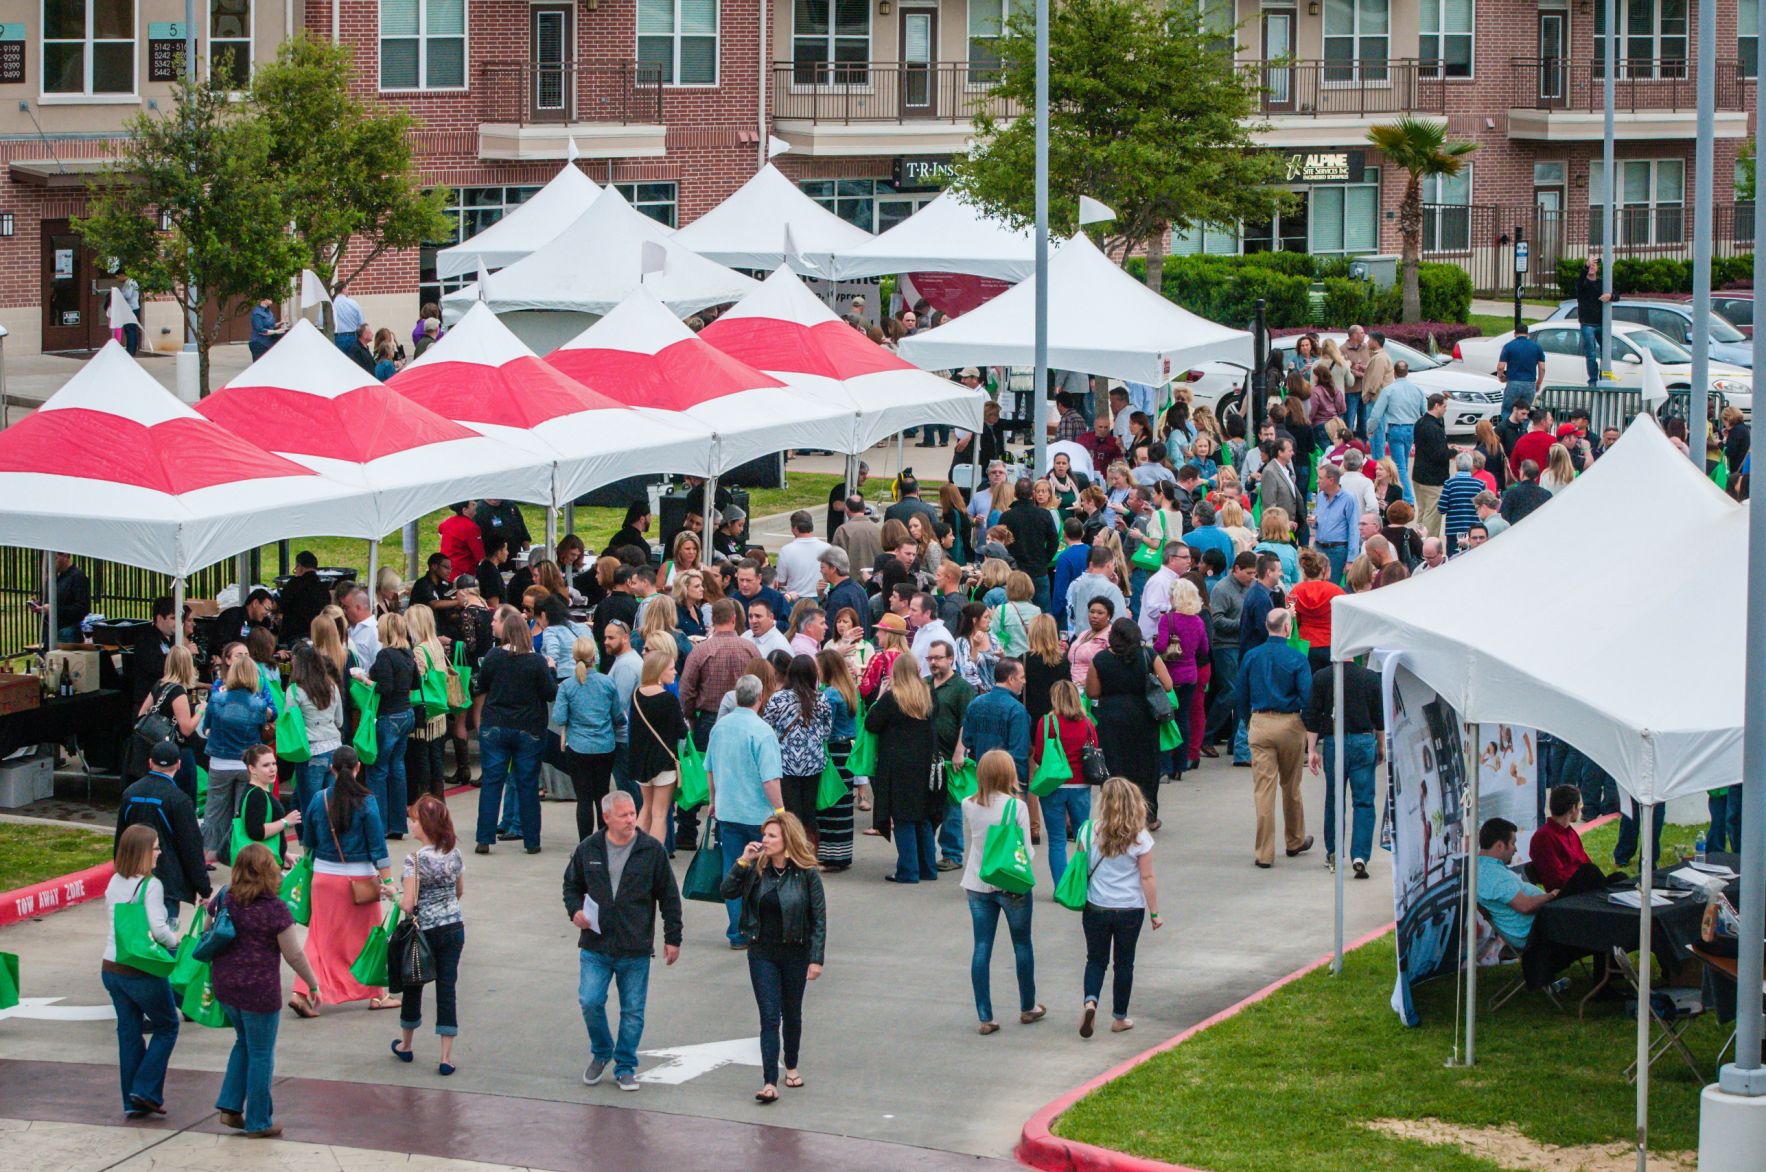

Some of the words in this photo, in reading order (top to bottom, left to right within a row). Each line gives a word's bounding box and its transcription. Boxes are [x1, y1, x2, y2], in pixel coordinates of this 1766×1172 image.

[169, 23, 178, 37] 5
[154, 43, 171, 51] 5142
[3, 53, 20, 61] 9299
[154, 51, 171, 59] 5242
[3, 62, 20, 70] 9399
[154, 60, 171, 68] 5342
[3, 70, 20, 78] 9499
[154, 68, 171, 76] 5442
[1305, 153, 1348, 167] ALPINE
[16, 895, 35, 917] TOW
[38, 887, 59, 909] AWAY
[63, 880, 86, 901] ZONE
